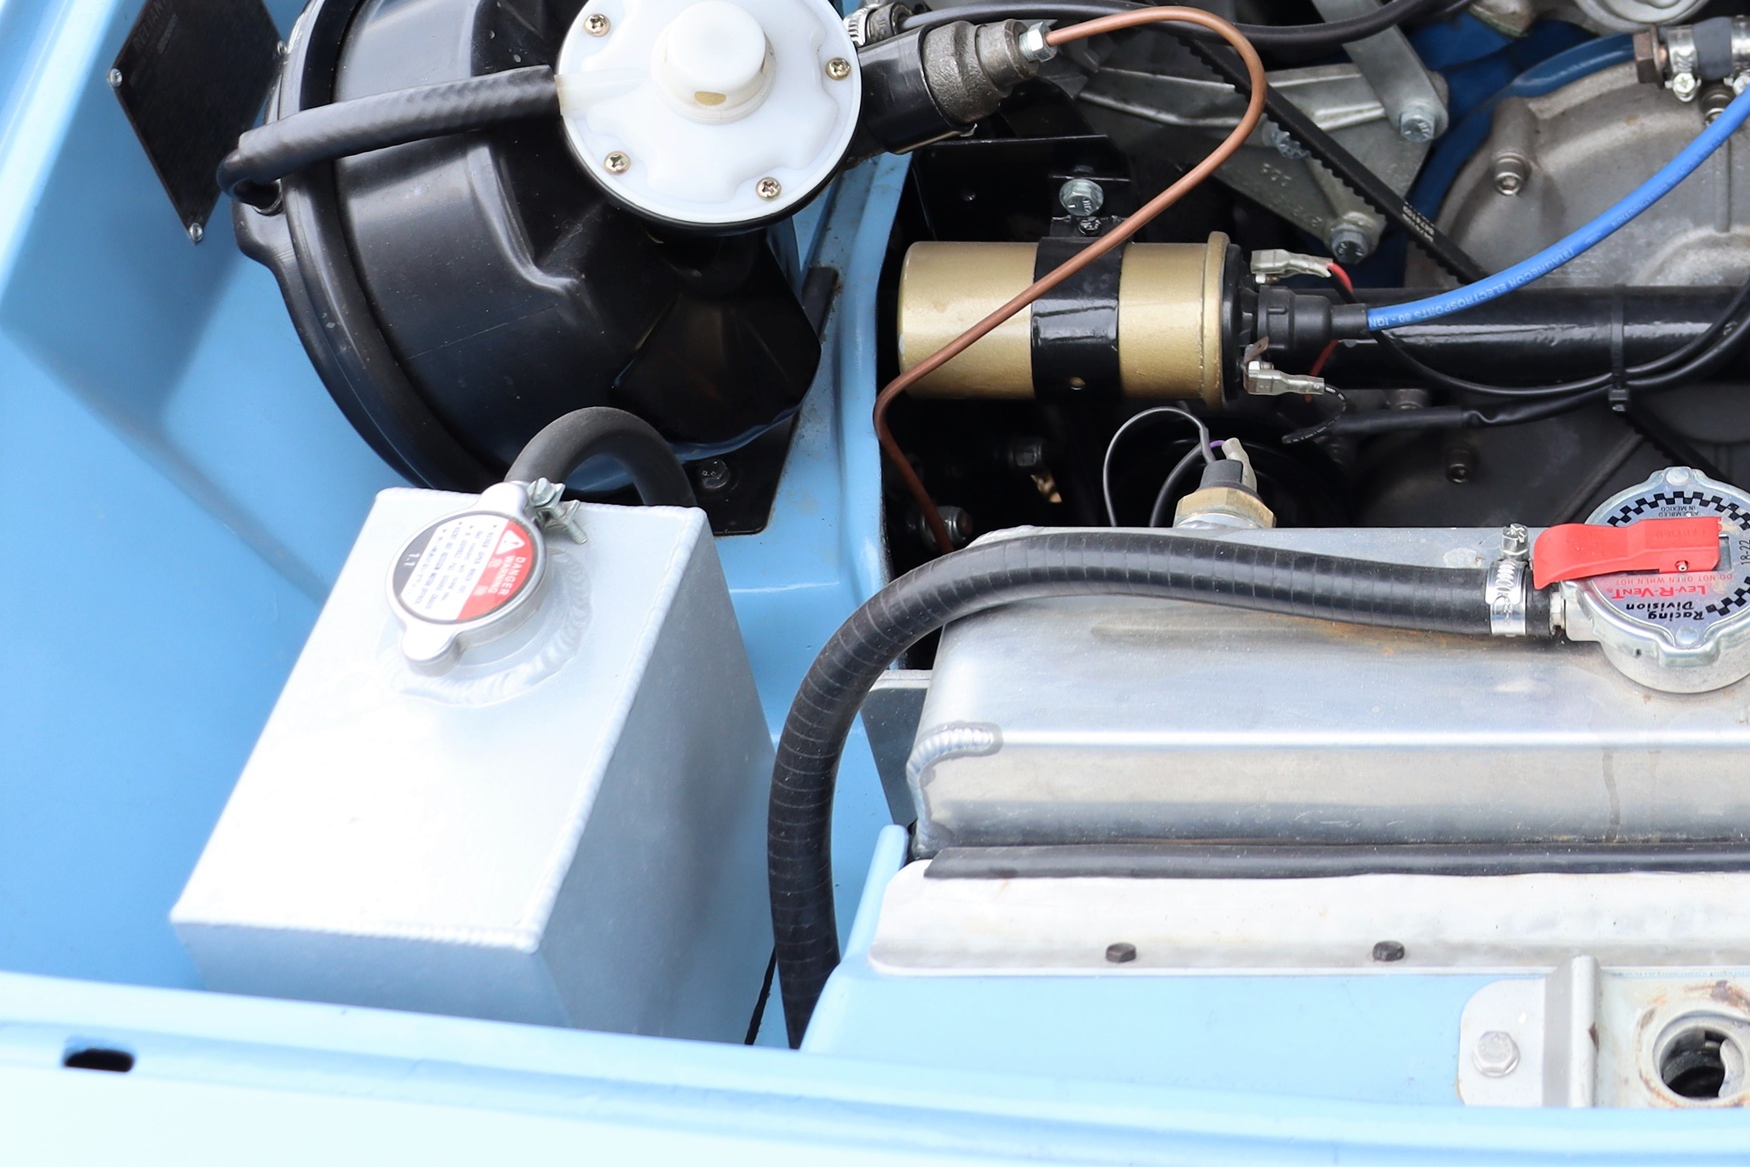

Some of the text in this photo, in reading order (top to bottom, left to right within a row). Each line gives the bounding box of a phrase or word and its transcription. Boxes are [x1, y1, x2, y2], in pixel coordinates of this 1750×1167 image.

[486, 555, 515, 594] WARNING
[496, 555, 527, 595] DANGER
[1636, 576, 1664, 584] WHEN
[1624, 600, 1694, 611] Division
[1647, 610, 1704, 621] Racing
